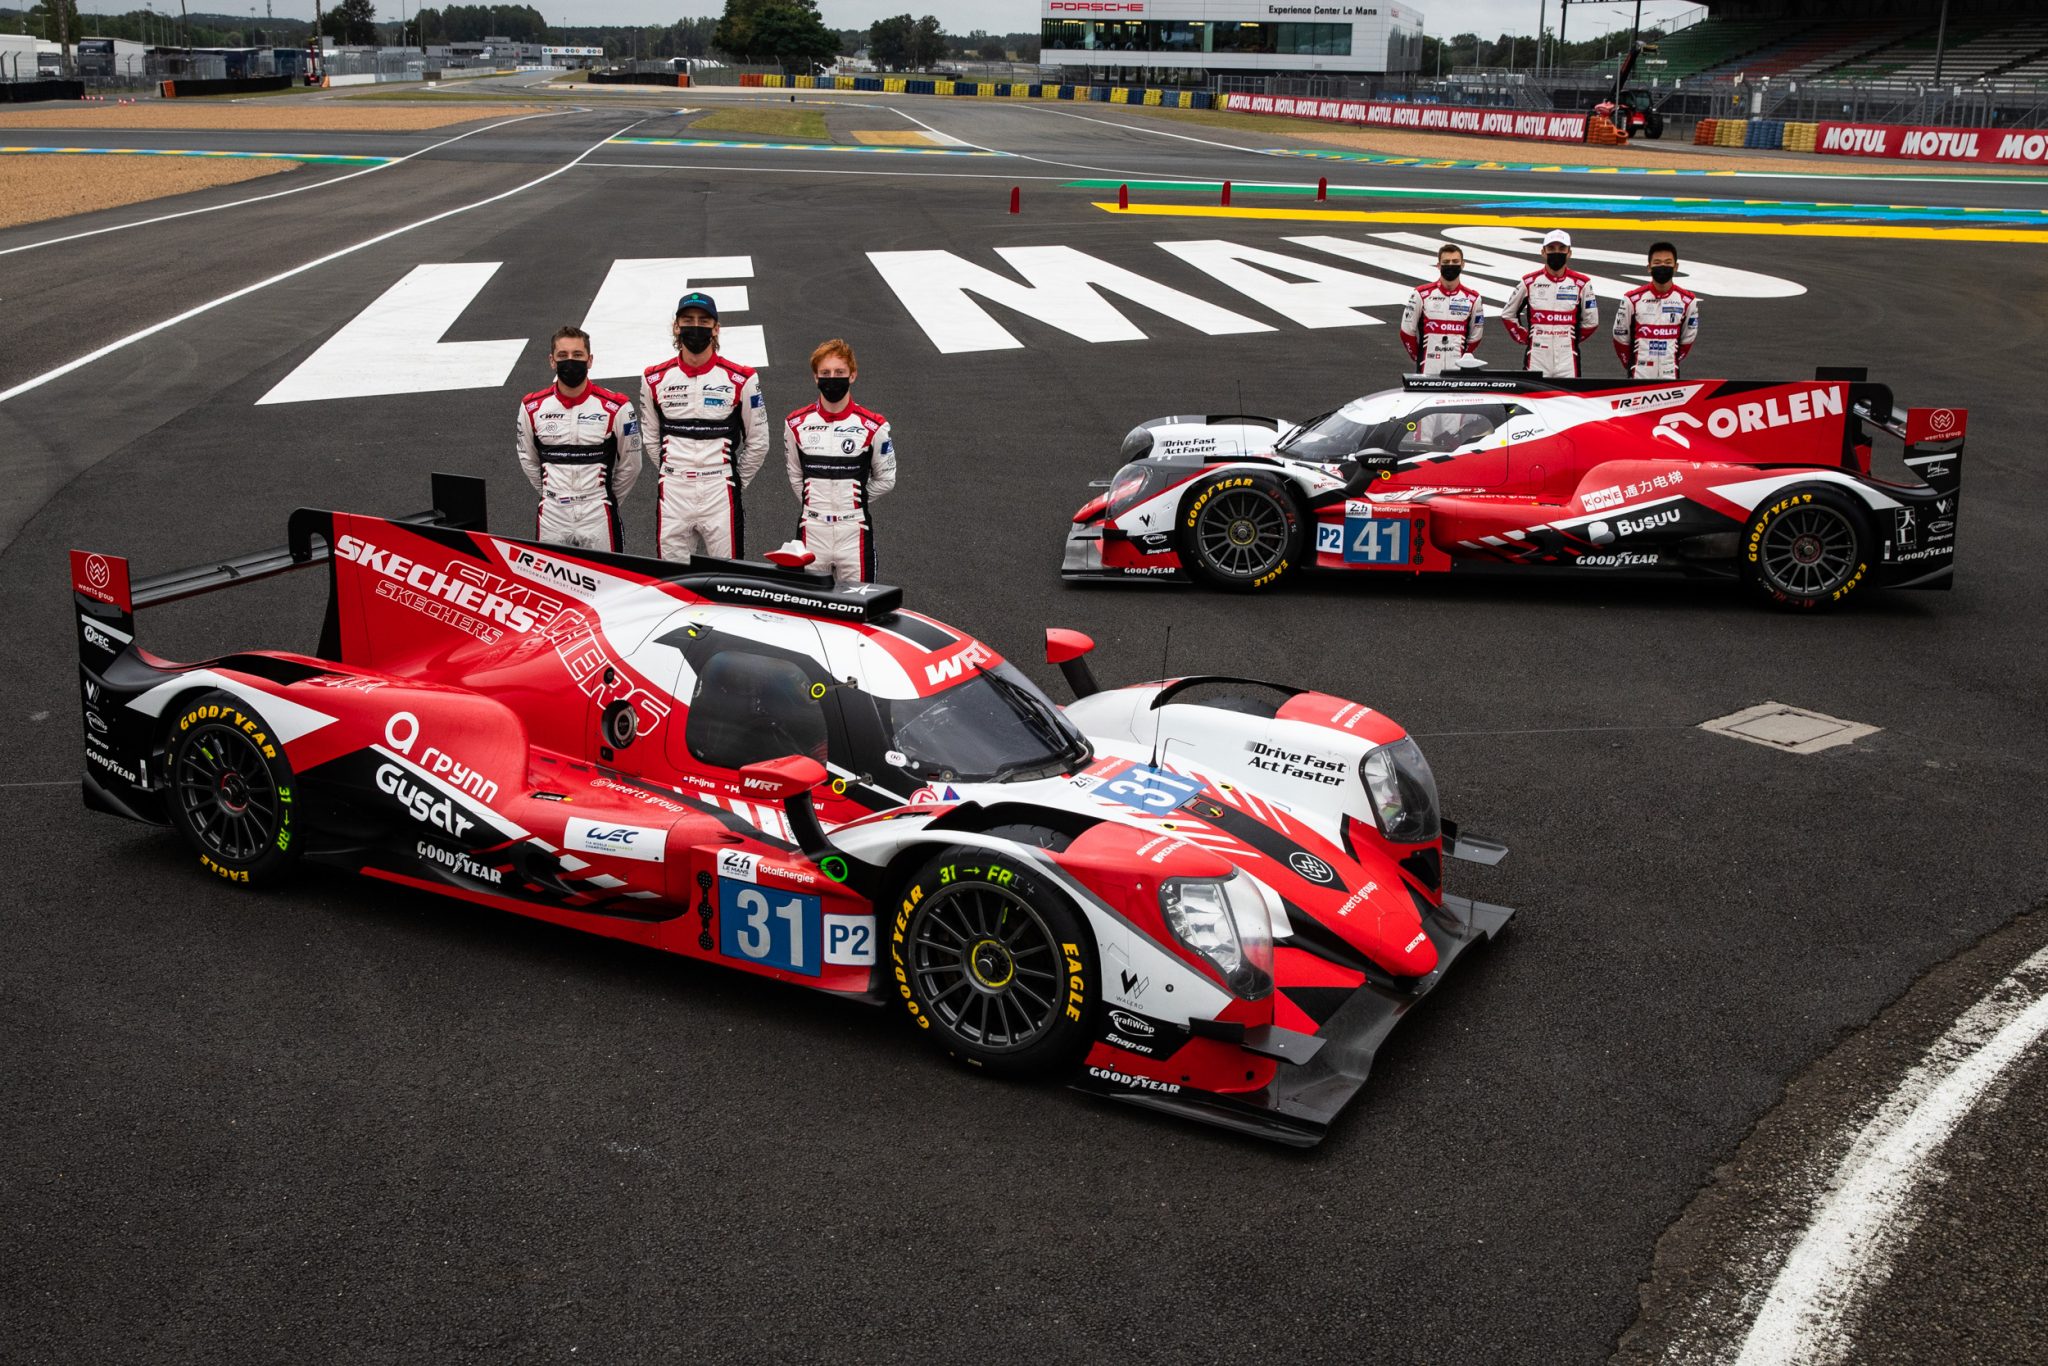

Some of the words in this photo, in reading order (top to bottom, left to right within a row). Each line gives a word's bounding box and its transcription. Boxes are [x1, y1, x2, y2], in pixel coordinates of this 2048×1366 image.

[1050, 2, 1144, 12] PORSCHE
[1268, 5, 1311, 17] Experience
[1314, 6, 1340, 16] Center
[1342, 6, 1354, 16] Le
[1356, 6, 1378, 16] Mans
[1229, 94, 1250, 109] MOTUL
[1252, 95, 1273, 112] MOTUL
[1275, 97, 1295, 114] MOTUL
[1295, 98, 1317, 116] MOTUL
[1319, 99, 1339, 118] MOTUL
[1341, 101, 1366, 120] MOTUL
[1368, 103, 1391, 123] MOTUL
[1393, 106, 1419, 125] MOTUL
[1421, 109, 1448, 128] MOTUL
[1450, 111, 1479, 130] MOTUL
[1482, 113, 1513, 133] MOTUL
[1515, 115, 1546, 135] MOTUL
[1548, 117, 1584, 138] MOTUL
[1823, 127, 1886, 153] MOTUL
[1900, 131, 1979, 157] MOTUL
[1996, 134, 2048, 160] MO
[254, 255, 770, 406] LE
[865, 226, 1808, 354] MANS
[1440, 323, 1465, 331] ORLEN
[702, 384, 733, 394] WEC
[1409, 380, 1517, 388] w-racingteam.com
[1619, 389, 1684, 408] REMUS
[577, 413, 608, 422] WEC
[1707, 385, 1844, 438] ORLEN
[834, 426, 865, 435] WEC
[1511, 427, 1535, 441] GPX
[1163, 446, 1181, 455] Act
[1182, 444, 1217, 454] Faster
[1164, 438, 1193, 448] Drive
[1196, 437, 1216, 447] Fast
[1624, 470, 1683, 499] 通力电梯
[1583, 488, 1622, 509] KONE
[1318, 526, 1341, 549] P2
[1352, 520, 1400, 561] 41
[518, 552, 597, 591] REMUS
[1253, 559, 1289, 588] EAGLE
[1832, 562, 1868, 600] EAGLE
[78, 582, 98, 596] weerts
[97, 590, 114, 602] group
[334, 534, 537, 634] SKECHERS
[716, 584, 864, 614] w-racingteam.com
[375, 580, 503, 646] SKECHERS
[925, 640, 993, 686] WRT
[1253, 742, 1303, 764] Drive
[1306, 753, 1347, 774] Fast
[688, 776, 716, 789] Frijns
[1248, 757, 1278, 773] Act
[1281, 764, 1346, 787] Faster
[278, 786, 292, 803] 31
[744, 777, 784, 792] WRT
[1109, 768, 1195, 807] 31
[606, 781, 648, 799] weerts
[644, 796, 684, 813] group
[276, 827, 292, 851] RR
[586, 827, 639, 843] WEC
[200, 853, 250, 882] EAGLE
[731, 867, 749, 875] MANS
[759, 864, 815, 884] TotalEnergies
[940, 864, 956, 884] 31
[987, 865, 1013, 886] FR
[736, 889, 804, 968] 31
[829, 924, 870, 956] P2
[1062, 942, 1085, 1022] EAGLE
[1116, 996, 1144, 1010] WALERO
[1112, 1013, 1155, 1035] GrafiWrap
[1105, 1032, 1153, 1054] Snap-on
[1089, 1067, 1181, 1094] GOODYEAR
